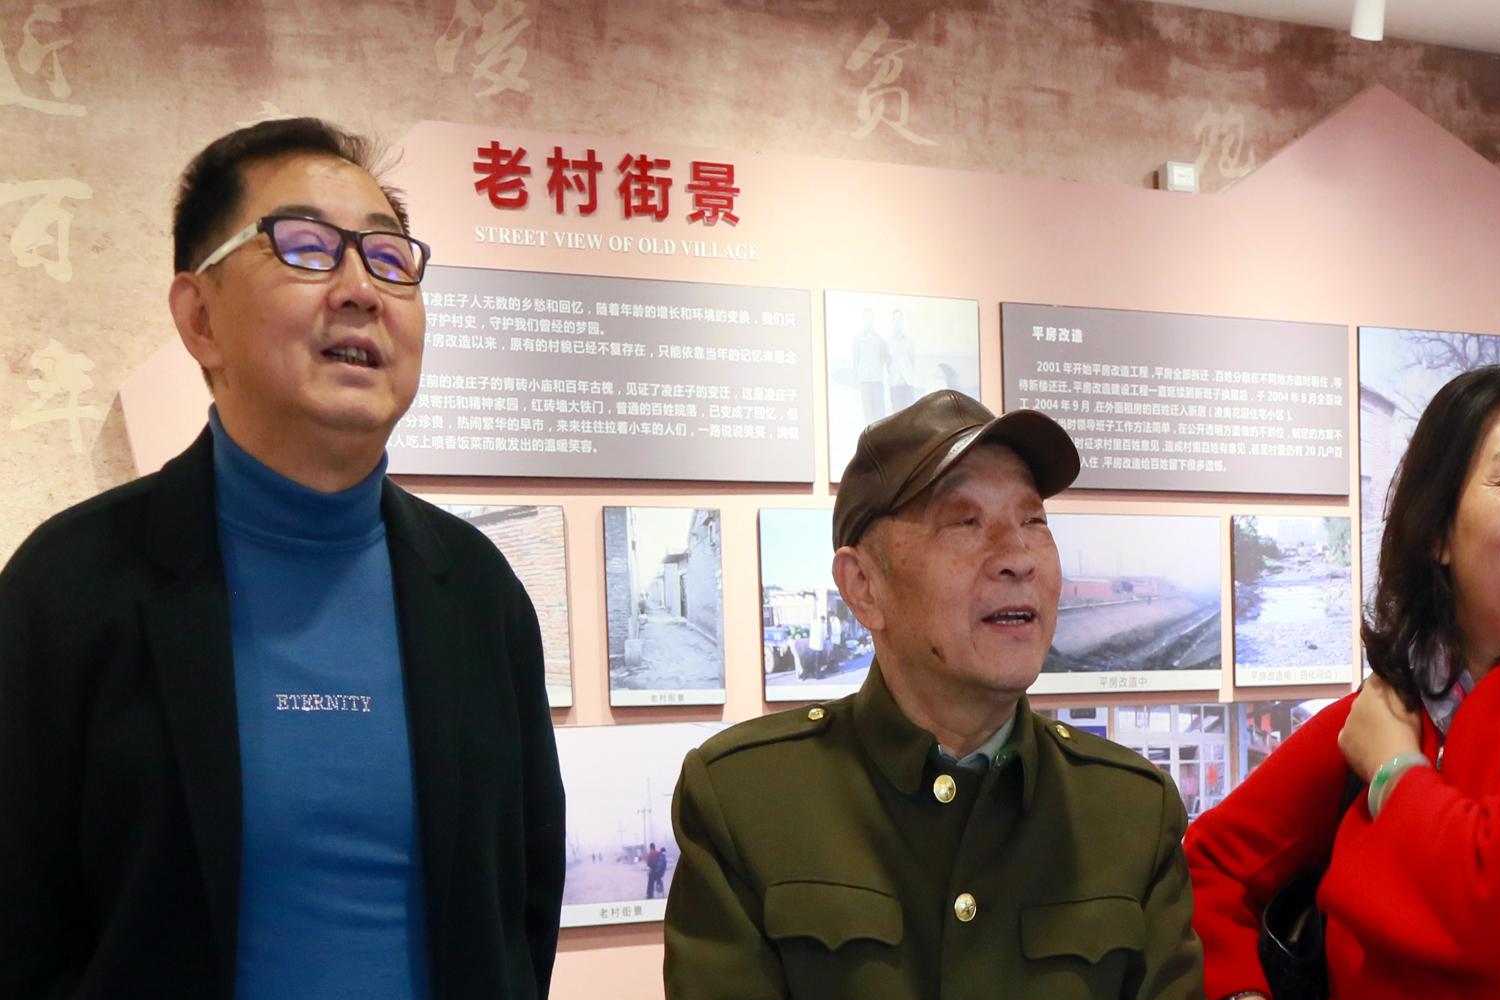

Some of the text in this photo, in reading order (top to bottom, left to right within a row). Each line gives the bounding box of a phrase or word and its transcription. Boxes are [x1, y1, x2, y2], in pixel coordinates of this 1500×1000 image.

[473, 140, 741, 227] 老村街景
[475, 226, 761, 262] STREET VIEW OF OLD VILLAGE
[1032, 326, 1083, 343] 平房改造
[275, 694, 371, 712] ETERNITY
[600, 904, 642, 919] 老村街景
